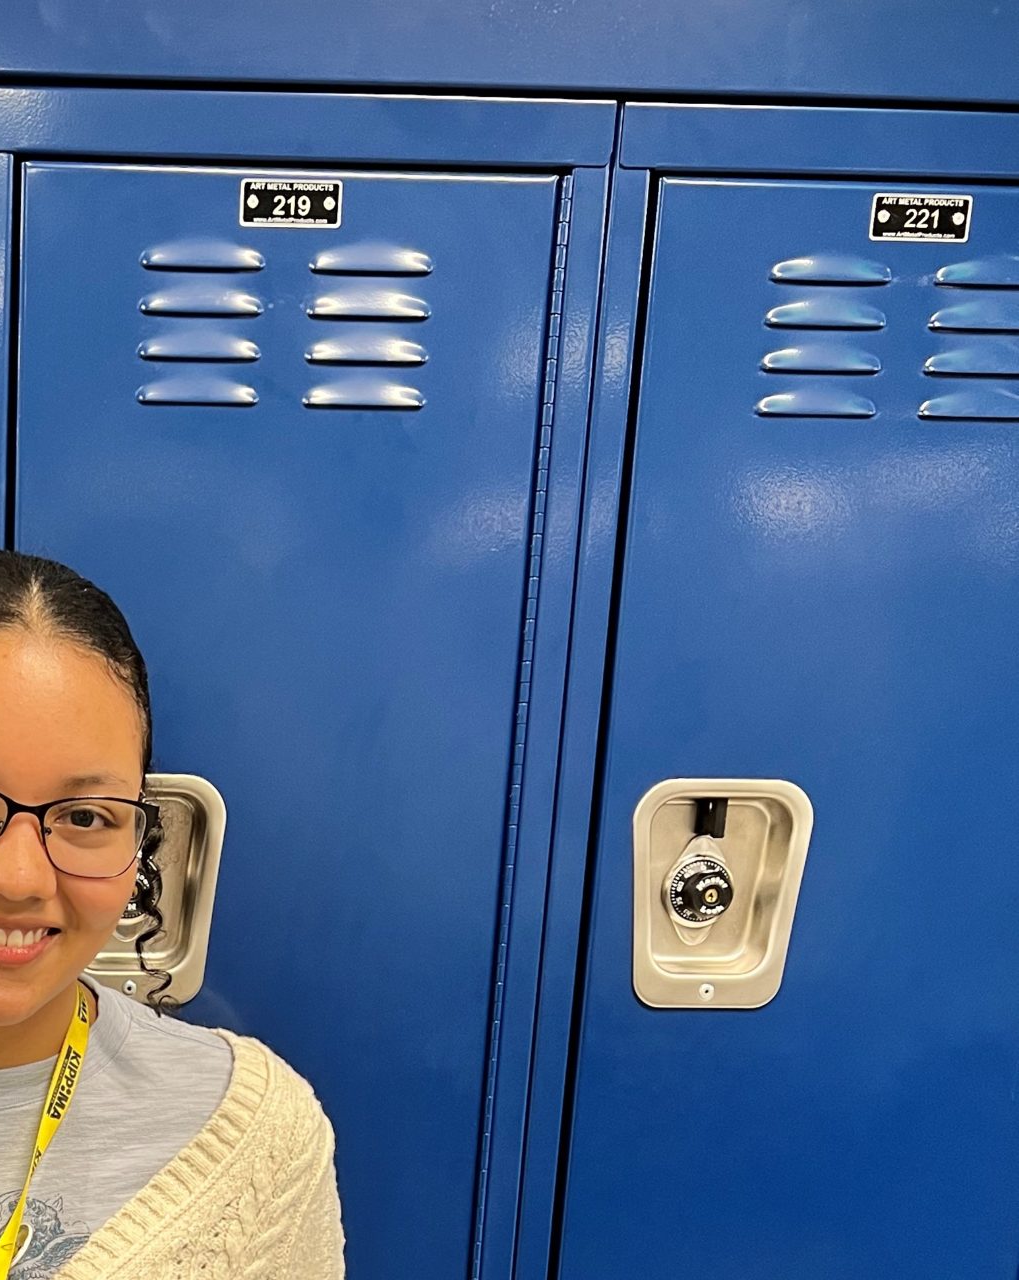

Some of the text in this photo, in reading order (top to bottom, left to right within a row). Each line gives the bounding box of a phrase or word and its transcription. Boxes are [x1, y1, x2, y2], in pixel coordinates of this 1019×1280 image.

[249, 182, 334, 192] ART METAL PRODUCTS
[272, 194, 311, 217] 219
[881, 197, 964, 207] ART METAL PRODUCTS
[903, 208, 940, 230] 221
[50, 1049, 82, 1120] KIPP:MA
